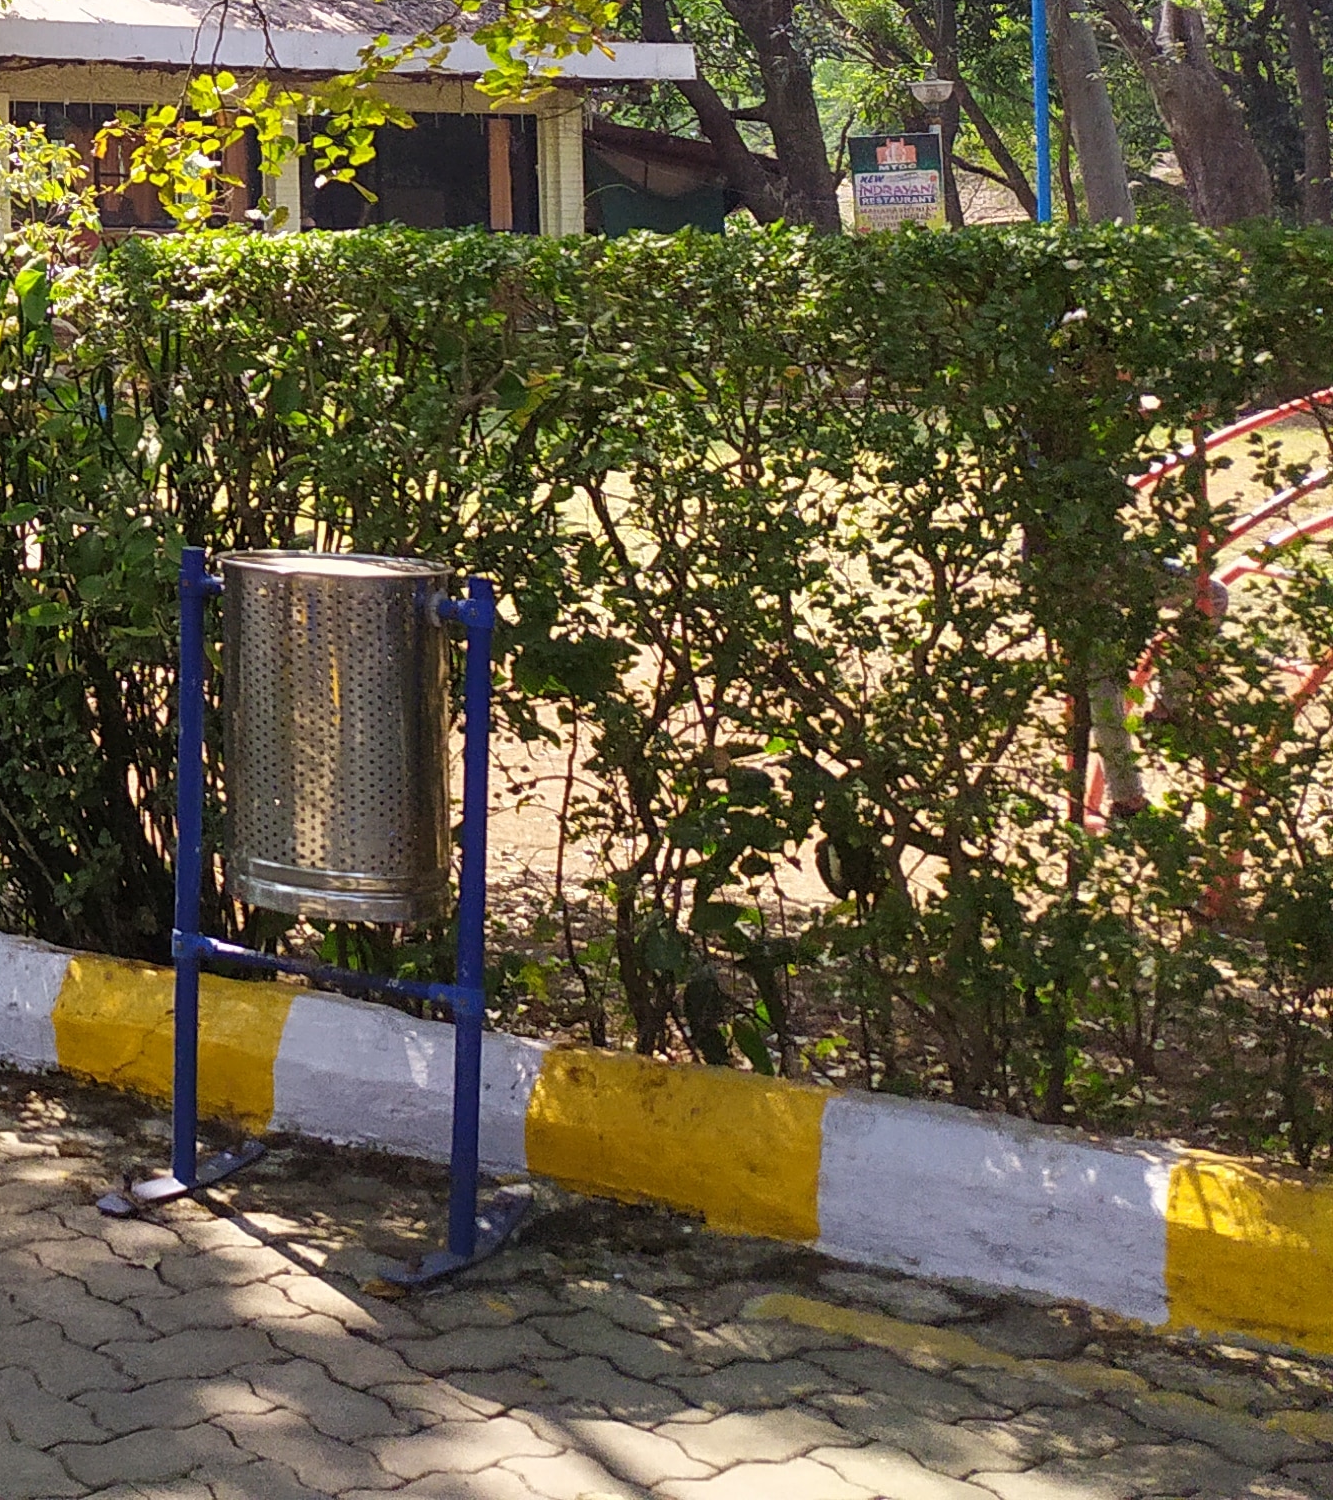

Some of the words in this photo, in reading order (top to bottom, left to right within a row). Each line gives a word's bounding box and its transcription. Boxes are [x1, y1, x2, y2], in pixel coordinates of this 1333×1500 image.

[878, 163, 917, 171] MTDC
[860, 175, 885, 183] NEW
[861, 196, 933, 204] RESTAURANT
